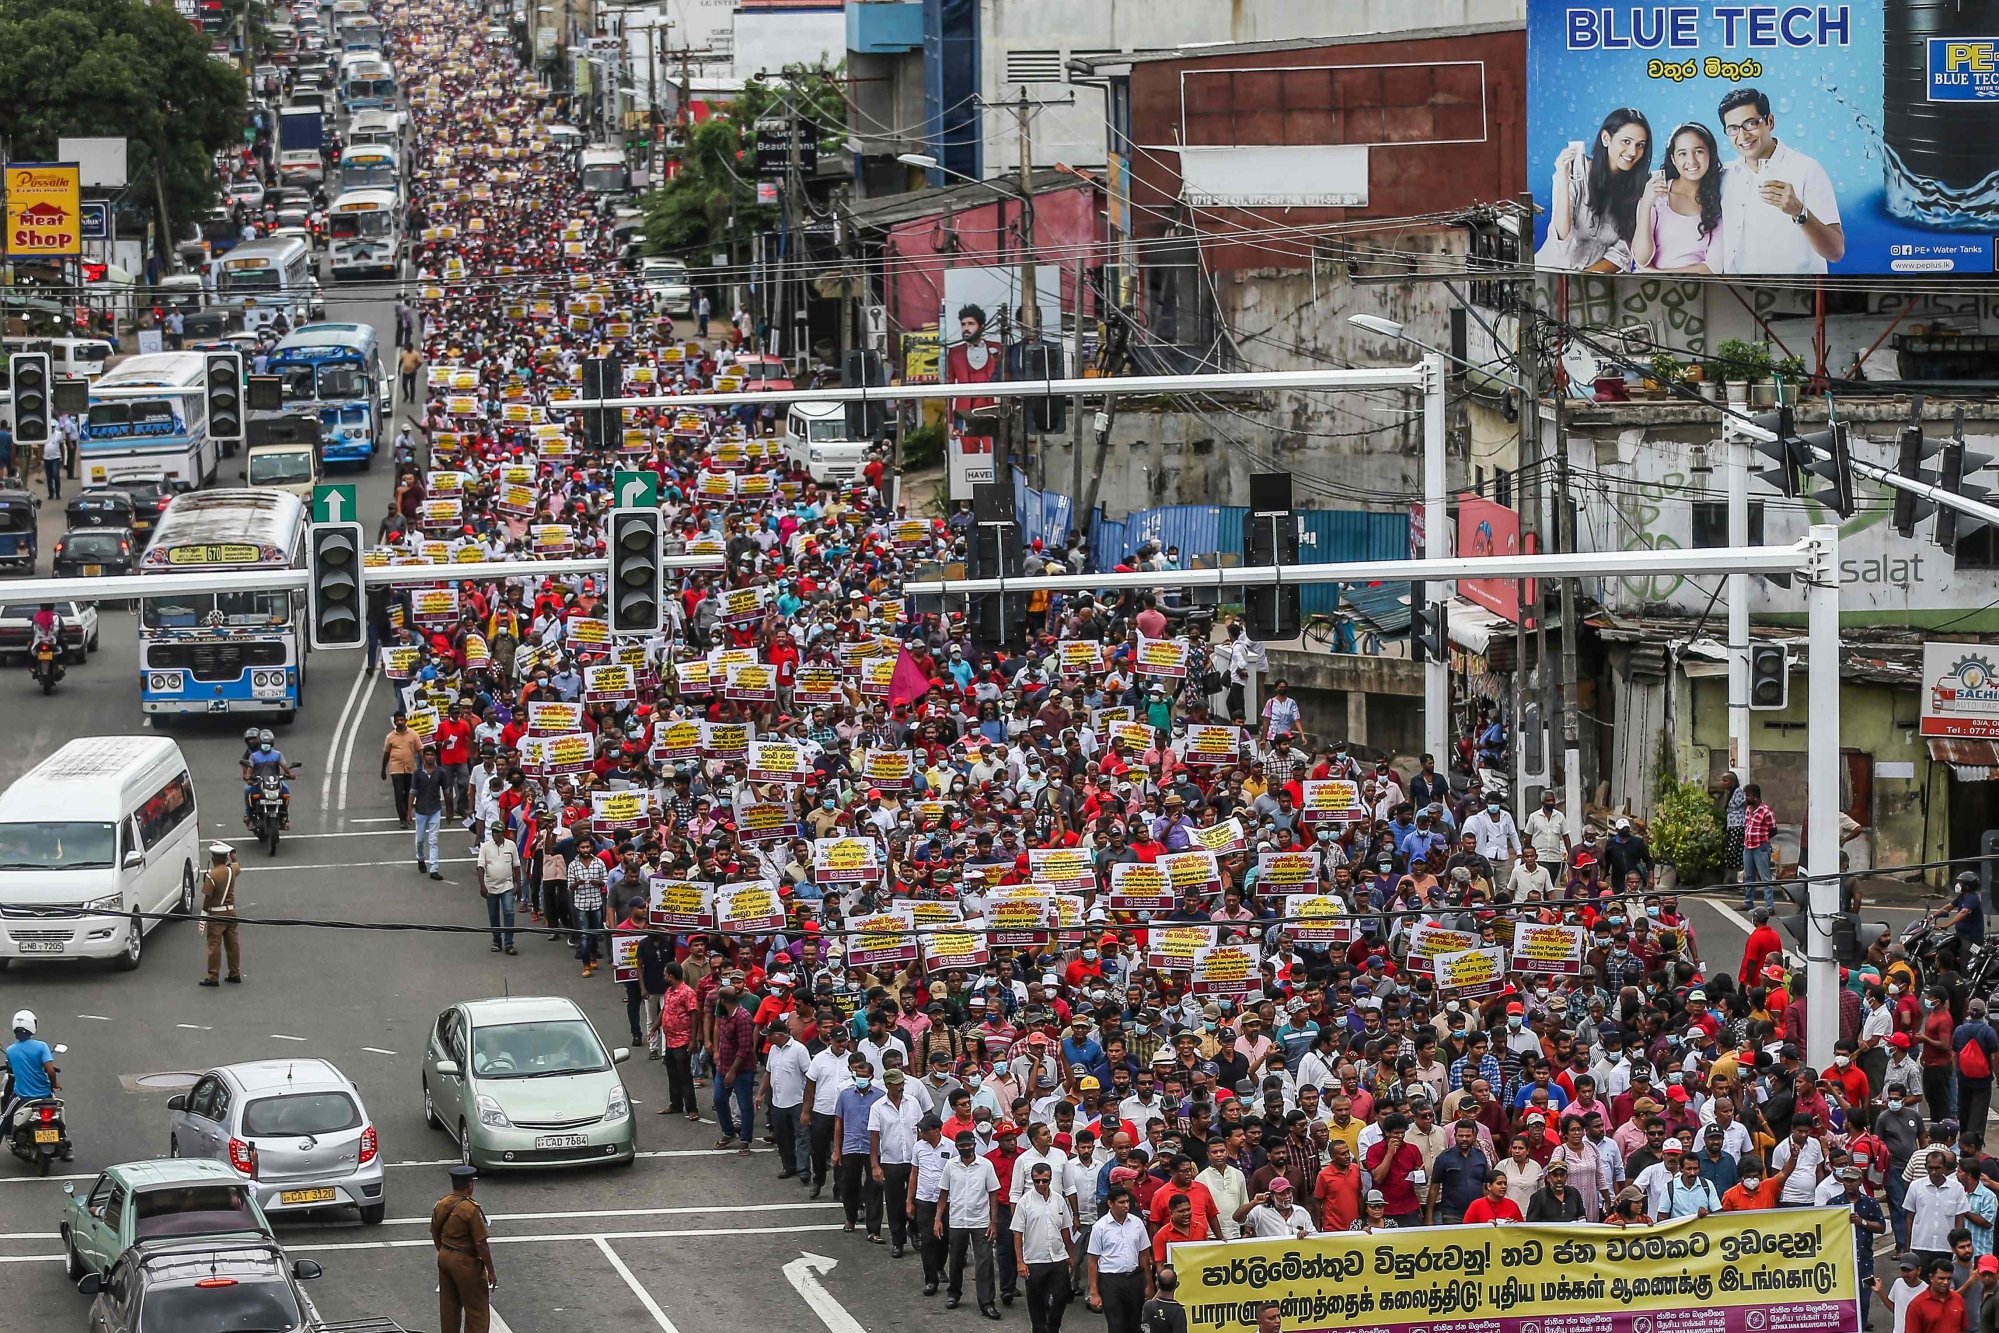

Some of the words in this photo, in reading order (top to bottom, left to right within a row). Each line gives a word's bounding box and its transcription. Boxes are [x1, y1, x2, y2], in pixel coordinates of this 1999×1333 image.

[1567, 8, 1698, 49] BLUE
[1714, 6, 1850, 47] TECH
[1946, 43, 1999, 72] PE
[1647, 59, 1697, 82] වතුර
[1704, 57, 1762, 82] මිතුරා
[1934, 73, 1968, 84] BLUE
[16, 171, 70, 188] Pussalla
[20, 215, 65, 226] Meat
[16, 230, 72, 248] Shop
[1960, 245, 1982, 253] Tanks
[1896, 261, 1950, 269] www.peplus.lk
[208, 547, 220, 560] 670
[1956, 701, 1976, 709] AUTO
[1982, 702, 1999, 710] PAR
[546, 1138, 562, 1146] CAD
[566, 1137, 586, 1146] 7684
[292, 1192, 308, 1201] CAT
[312, 1190, 334, 1200] 3120
[1202, 1250, 1364, 1288] පාර්ලිමේන්තුව
[1374, 1242, 1490, 1279] විසුරුවනු!
[1501, 1239, 1543, 1267] නව
[1553, 1238, 1596, 1264] ජන
[1606, 1232, 1710, 1262] වරමකට
[1720, 1224, 1822, 1262] ඉඩදෙනු!
[1192, 1286, 1374, 1330] பாராளுன்றத்தைக்
[1378, 1280, 1482, 1315] கலைத்திடு!
[1489, 1276, 1534, 1310] புதிய
[1541, 1273, 1604, 1303] மக்கள்
[1610, 1268, 1713, 1304] ஆணைக்கு
[1718, 1262, 1838, 1295] இடங்கொடு!
[1795, 1313, 1820, 1321] மக்கள்
[1822, 1312, 1840, 1320] சக்தி
[1682, 1319, 1706, 1327] மக்கள்
[1708, 1318, 1725, 1327] சக்தி
